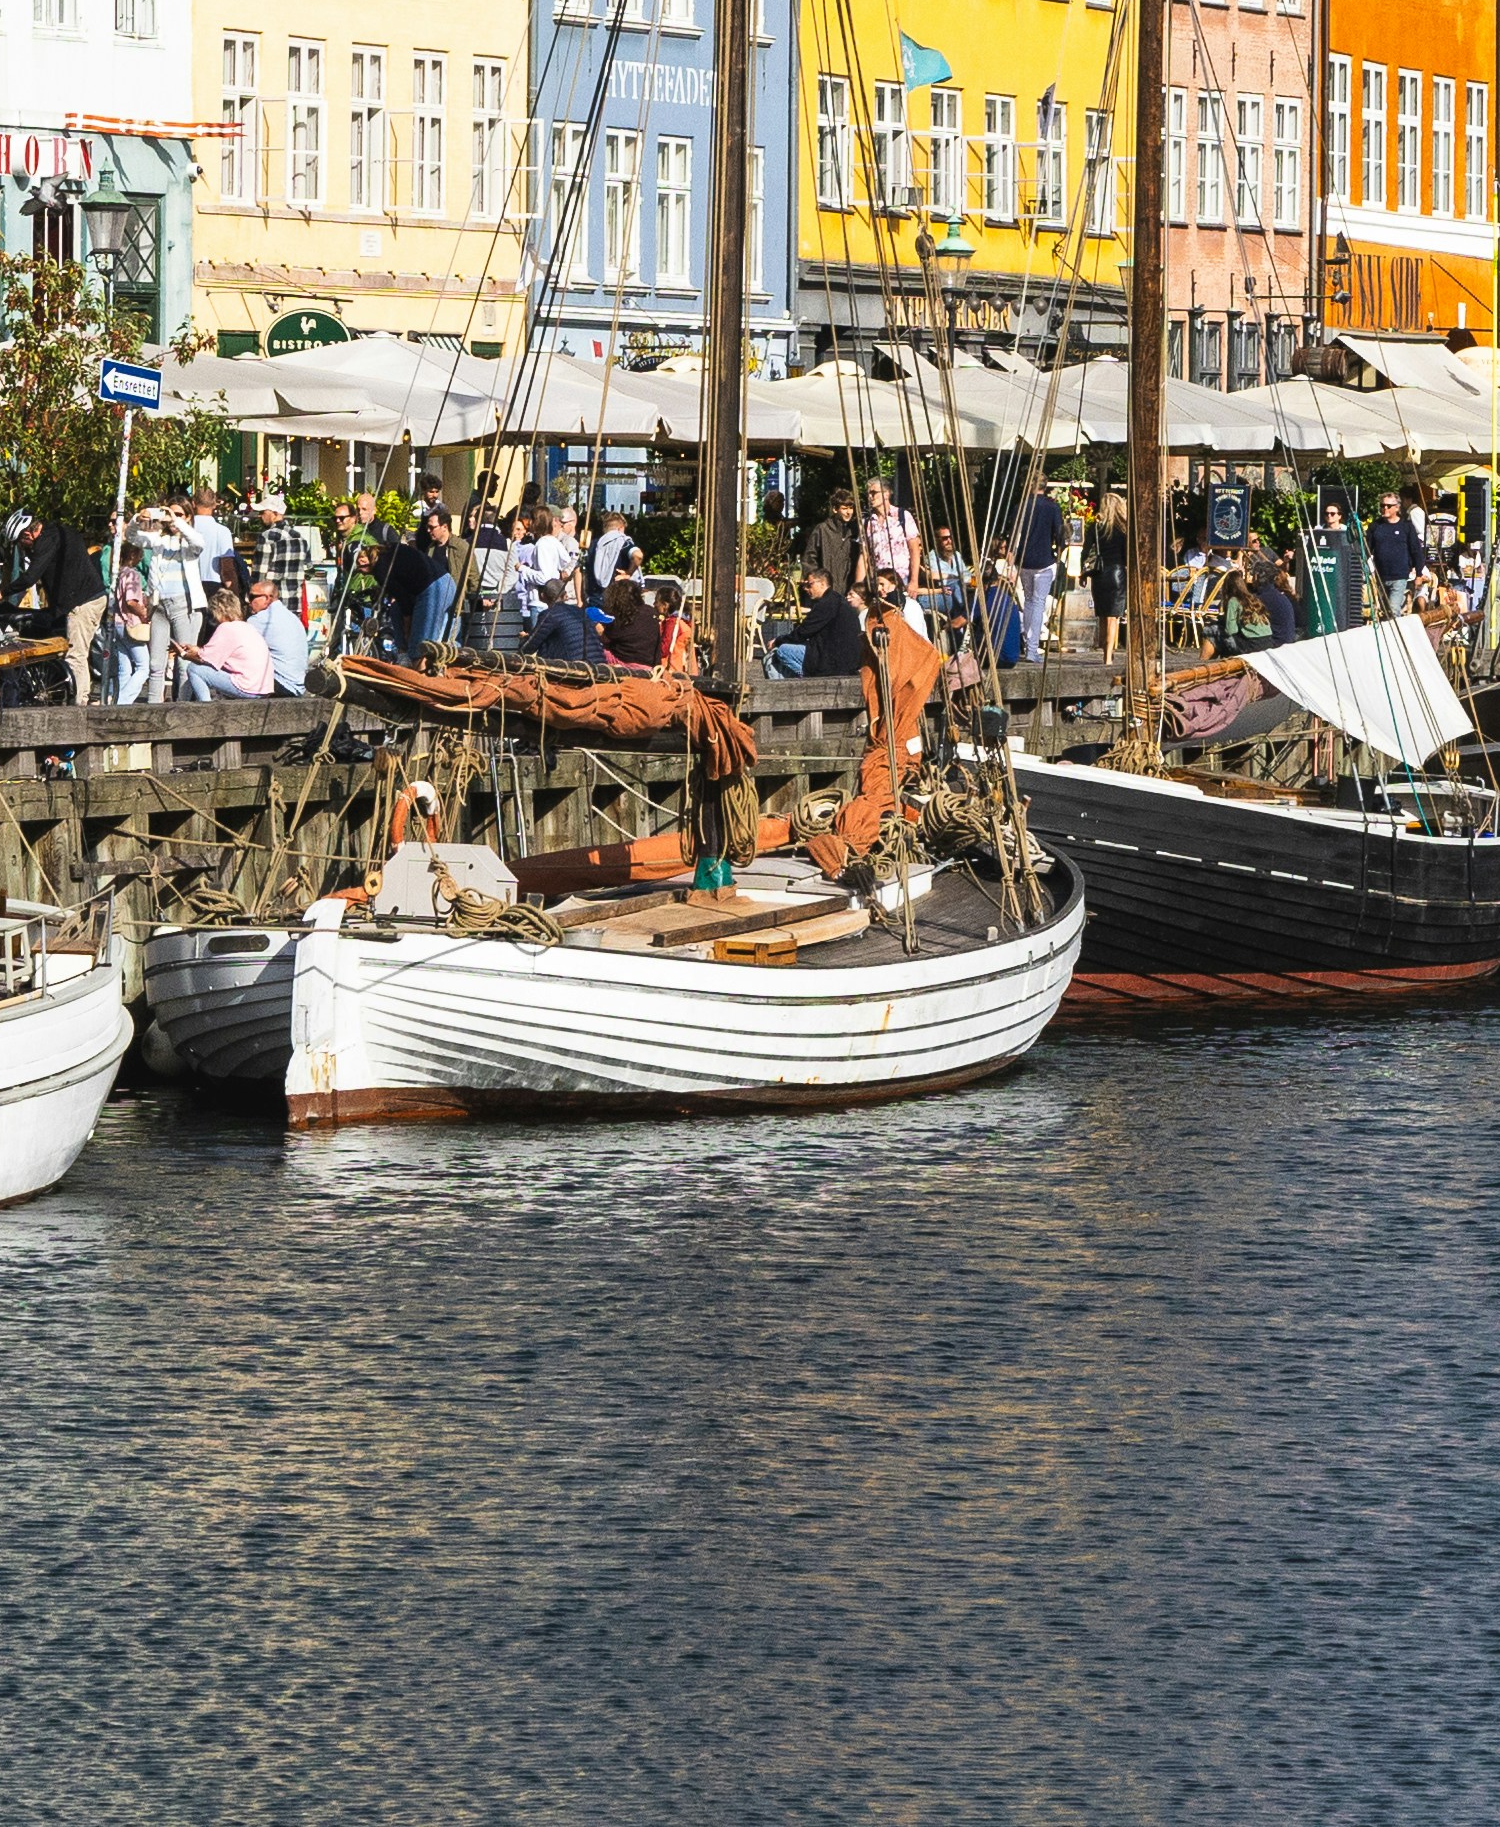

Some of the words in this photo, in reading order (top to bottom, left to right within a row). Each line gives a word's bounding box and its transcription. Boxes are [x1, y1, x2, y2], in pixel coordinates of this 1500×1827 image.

[273, 339, 323, 350] BISTRO
[113, 375, 156, 397] Ensrettet
[112, 748, 119, 766] 8
